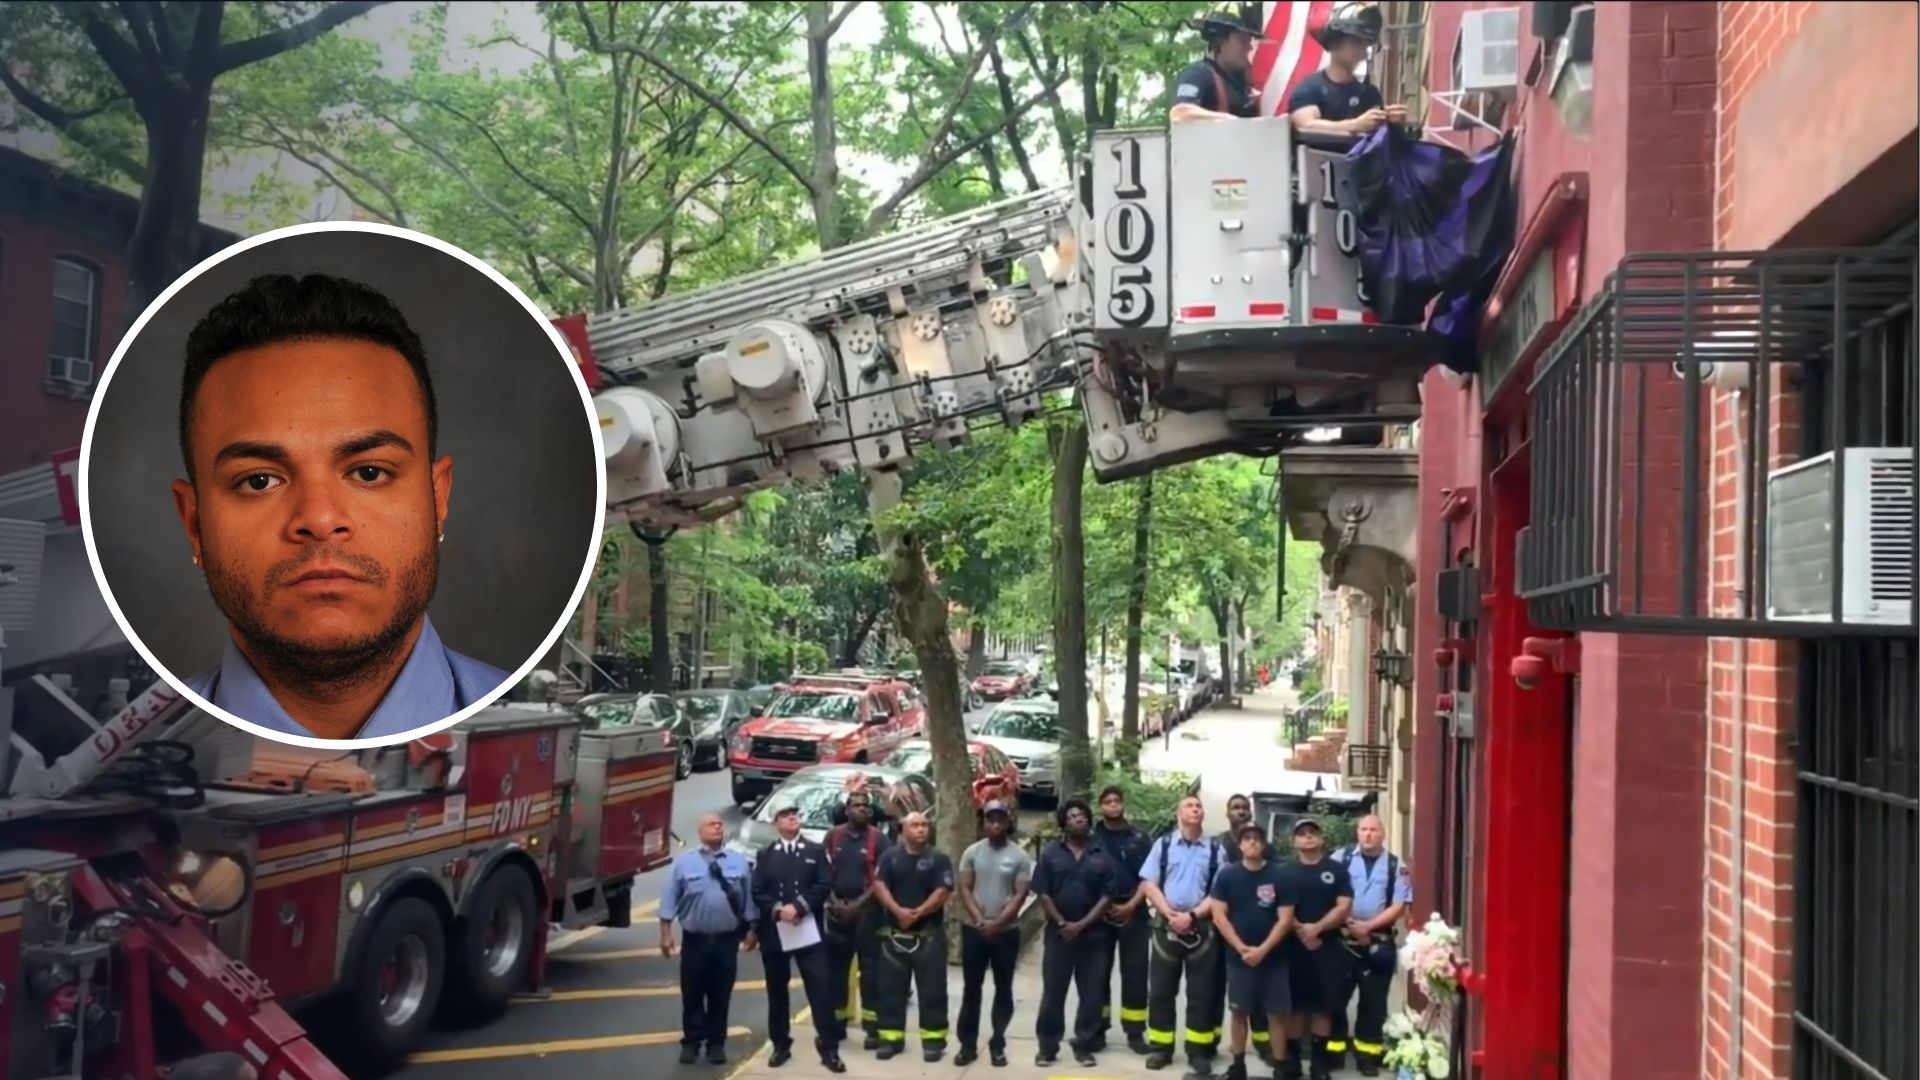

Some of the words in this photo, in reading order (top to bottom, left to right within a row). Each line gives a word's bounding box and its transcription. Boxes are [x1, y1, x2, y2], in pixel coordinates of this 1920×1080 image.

[1104, 137, 1155, 328] 105
[1320, 160, 1371, 306] 10
[490, 794, 533, 835] FDNY
